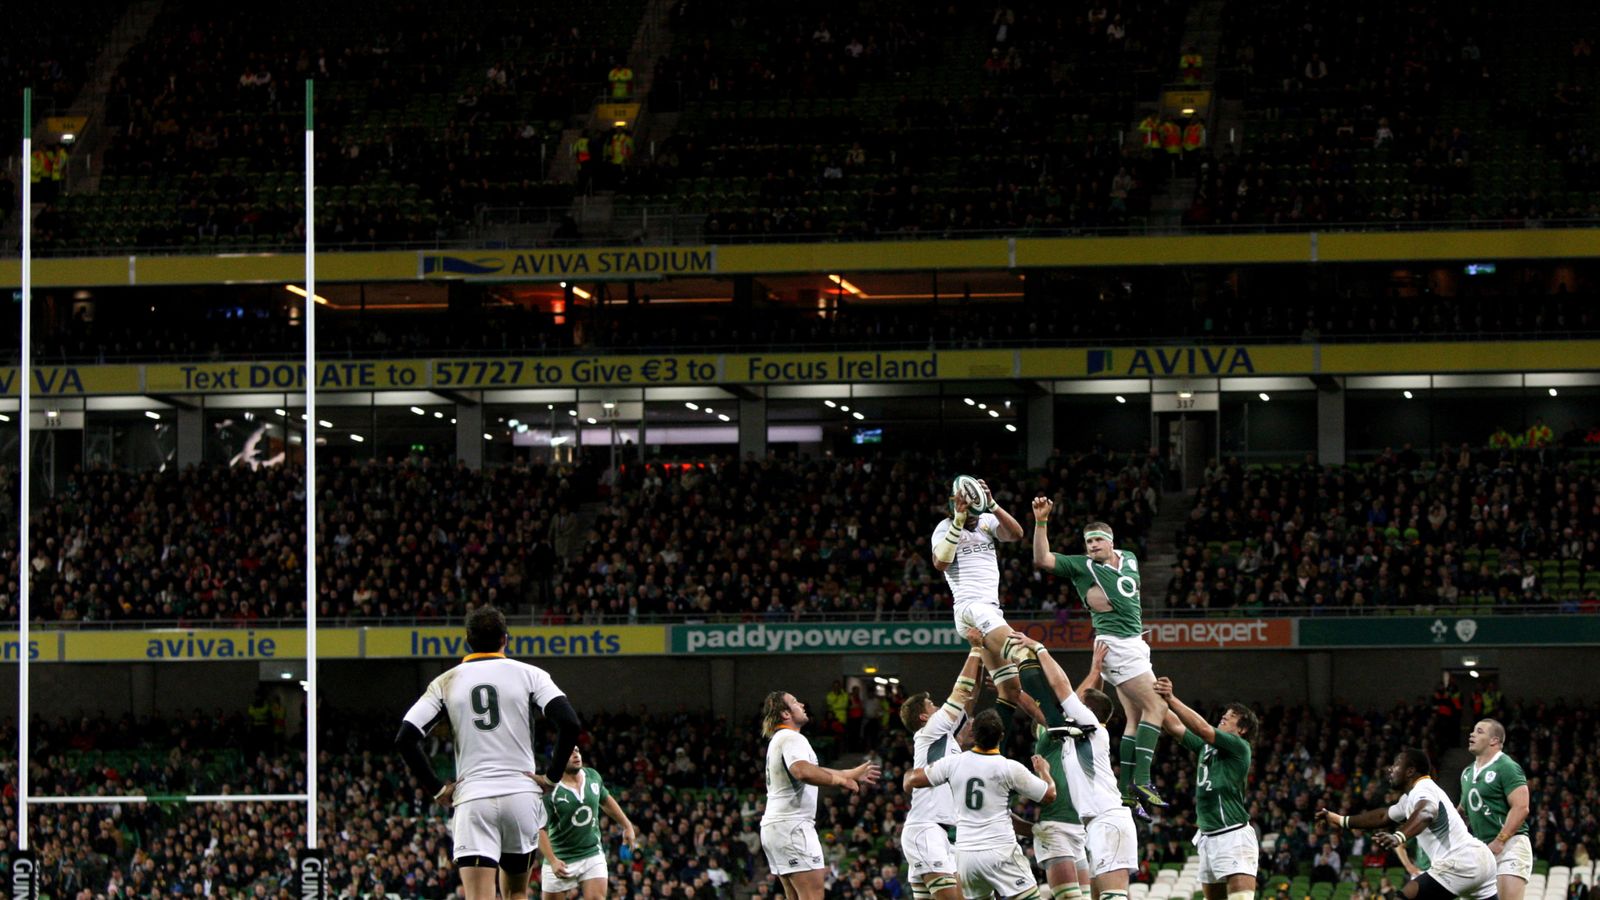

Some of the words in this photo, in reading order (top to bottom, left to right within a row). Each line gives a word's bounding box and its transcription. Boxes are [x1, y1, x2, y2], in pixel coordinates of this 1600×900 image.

[512, 254, 590, 274] AVIVA
[598, 251, 713, 272] STADIUM
[180, 366, 239, 389] Text
[388, 364, 416, 385] to
[436, 361, 524, 385] 57727
[534, 362, 562, 383] to
[571, 358, 632, 382] Give
[641, 358, 679, 381] €3
[688, 358, 716, 380] to
[748, 357, 828, 381] Focus
[838, 353, 938, 379] Ireland
[1127, 348, 1255, 374] AVIVA
[0, 369, 84, 393] VVA
[1176, 399, 1195, 410] 317
[0, 639, 39, 660] ns
[146, 632, 276, 658] aviva.ie
[687, 624, 963, 651] paddypower.com
[471, 684, 501, 731] 9
[965, 777, 985, 811] 6
